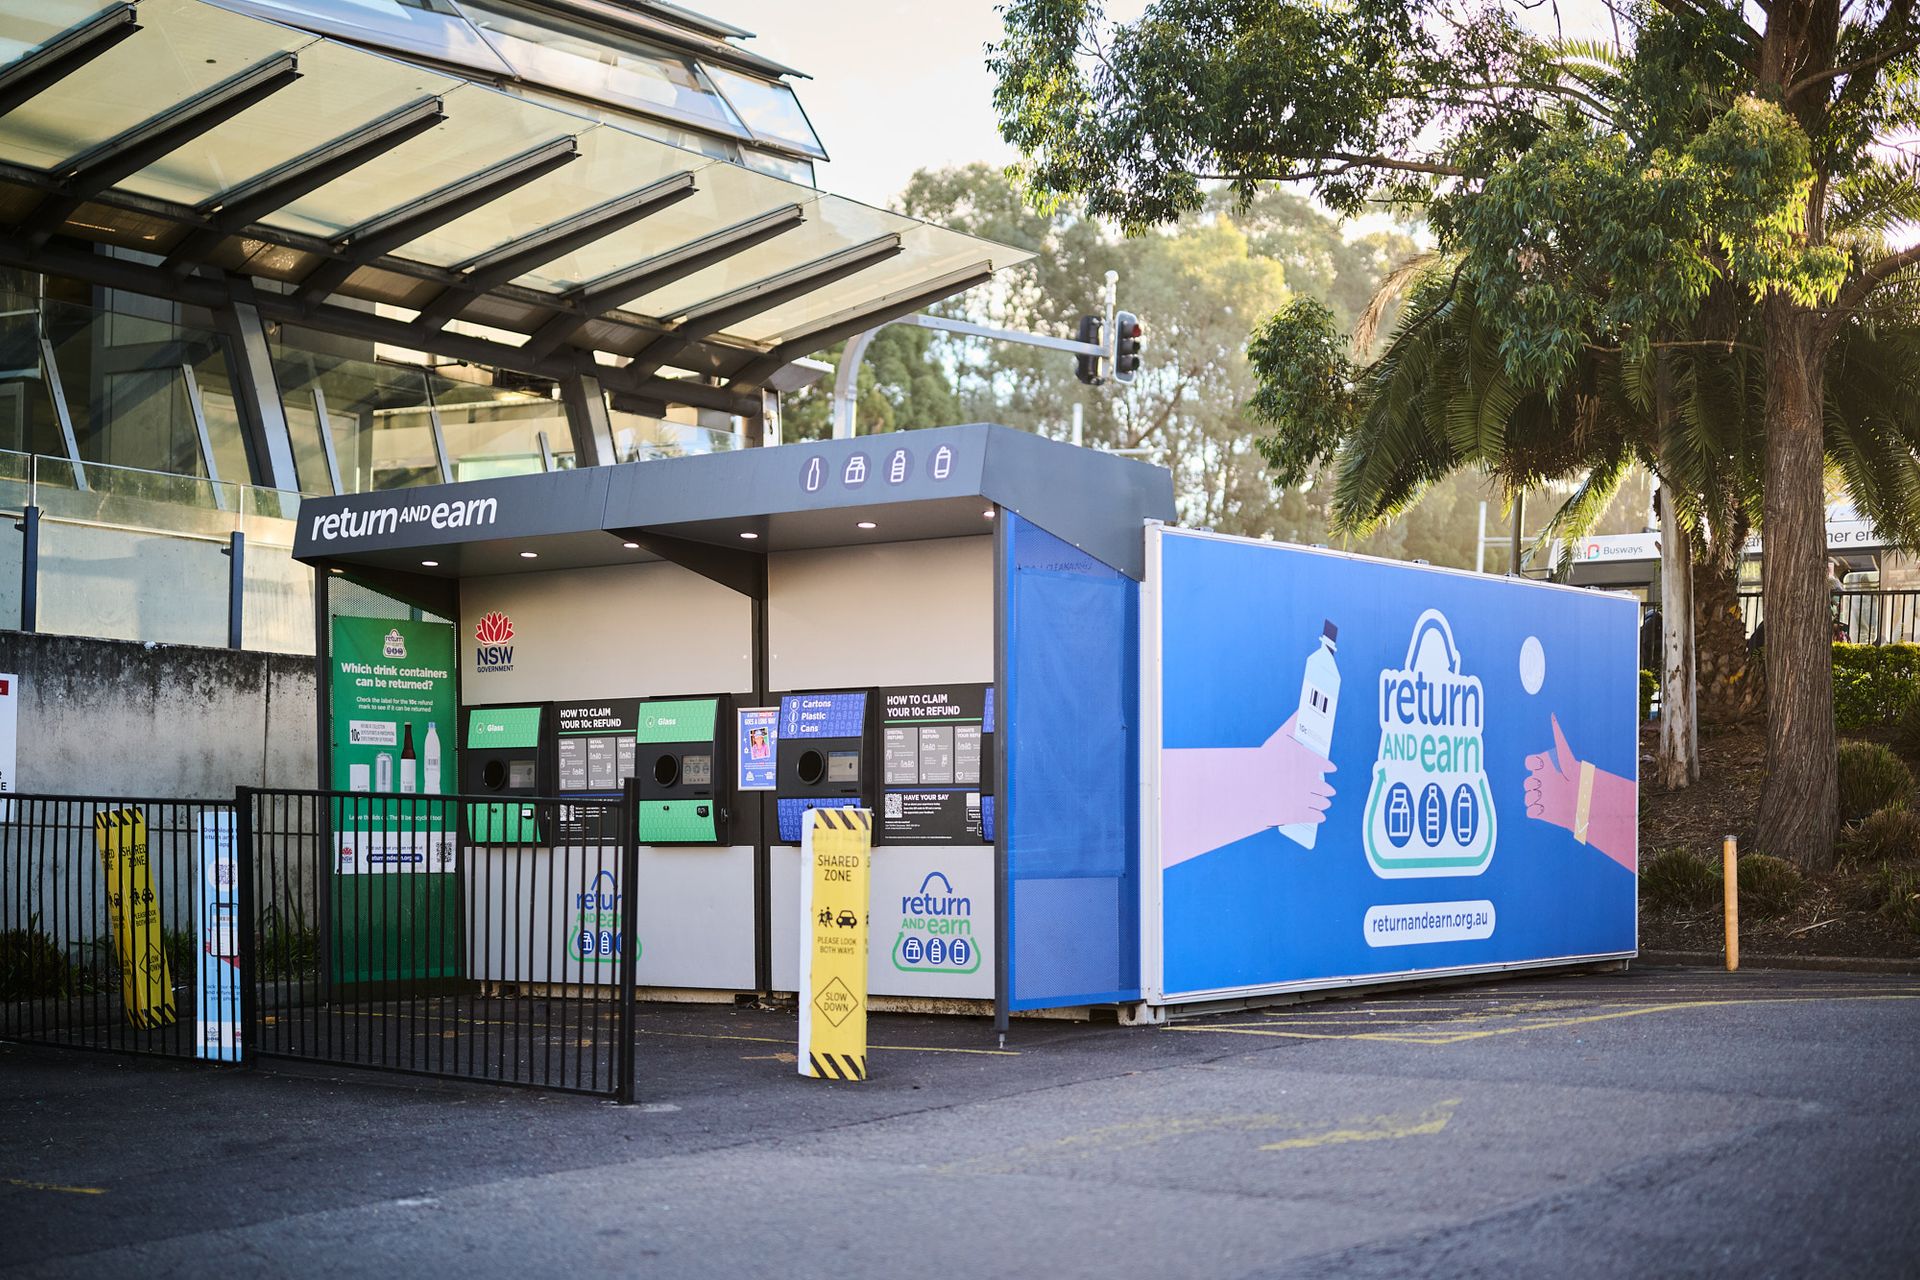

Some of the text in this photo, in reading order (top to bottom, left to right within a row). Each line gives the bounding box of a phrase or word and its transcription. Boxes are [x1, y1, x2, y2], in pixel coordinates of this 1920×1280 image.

[312, 497, 497, 541] return AND earn
[1603, 545, 1643, 556] Busways
[477, 646, 514, 666] NSW
[341, 662, 448, 679] Which drink containers
[477, 665, 514, 673] GOVERNMENT
[356, 677, 433, 690] can be returned?
[802, 700, 831, 708] Cartons
[887, 694, 948, 706] HOW TO CLAIM
[1384, 671, 1480, 727] return
[560, 707, 611, 718] HOW TO CLAIM
[801, 712, 826, 720] Plastic
[887, 706, 960, 717] YOUR 10c REFUND
[560, 719, 621, 729] YOUR 10c REFUND
[657, 717, 676, 726] Glass
[486, 724, 504, 732] Glass
[800, 724, 819, 732] Cans
[351, 728, 360, 742] 10c
[1383, 732, 1480, 773] AND earn
[817, 854, 860, 868] SHARED
[824, 869, 852, 882] ZONE
[902, 893, 971, 916] return
[902, 918, 971, 935] AND earn
[1372, 909, 1488, 934] returnandearn.org.au
[817, 936, 857, 946] PLEASE LOOK
[819, 946, 855, 955] BOTH WAYS
[825, 992, 848, 1002] SLOW
[823, 1001, 849, 1013] DOWN
